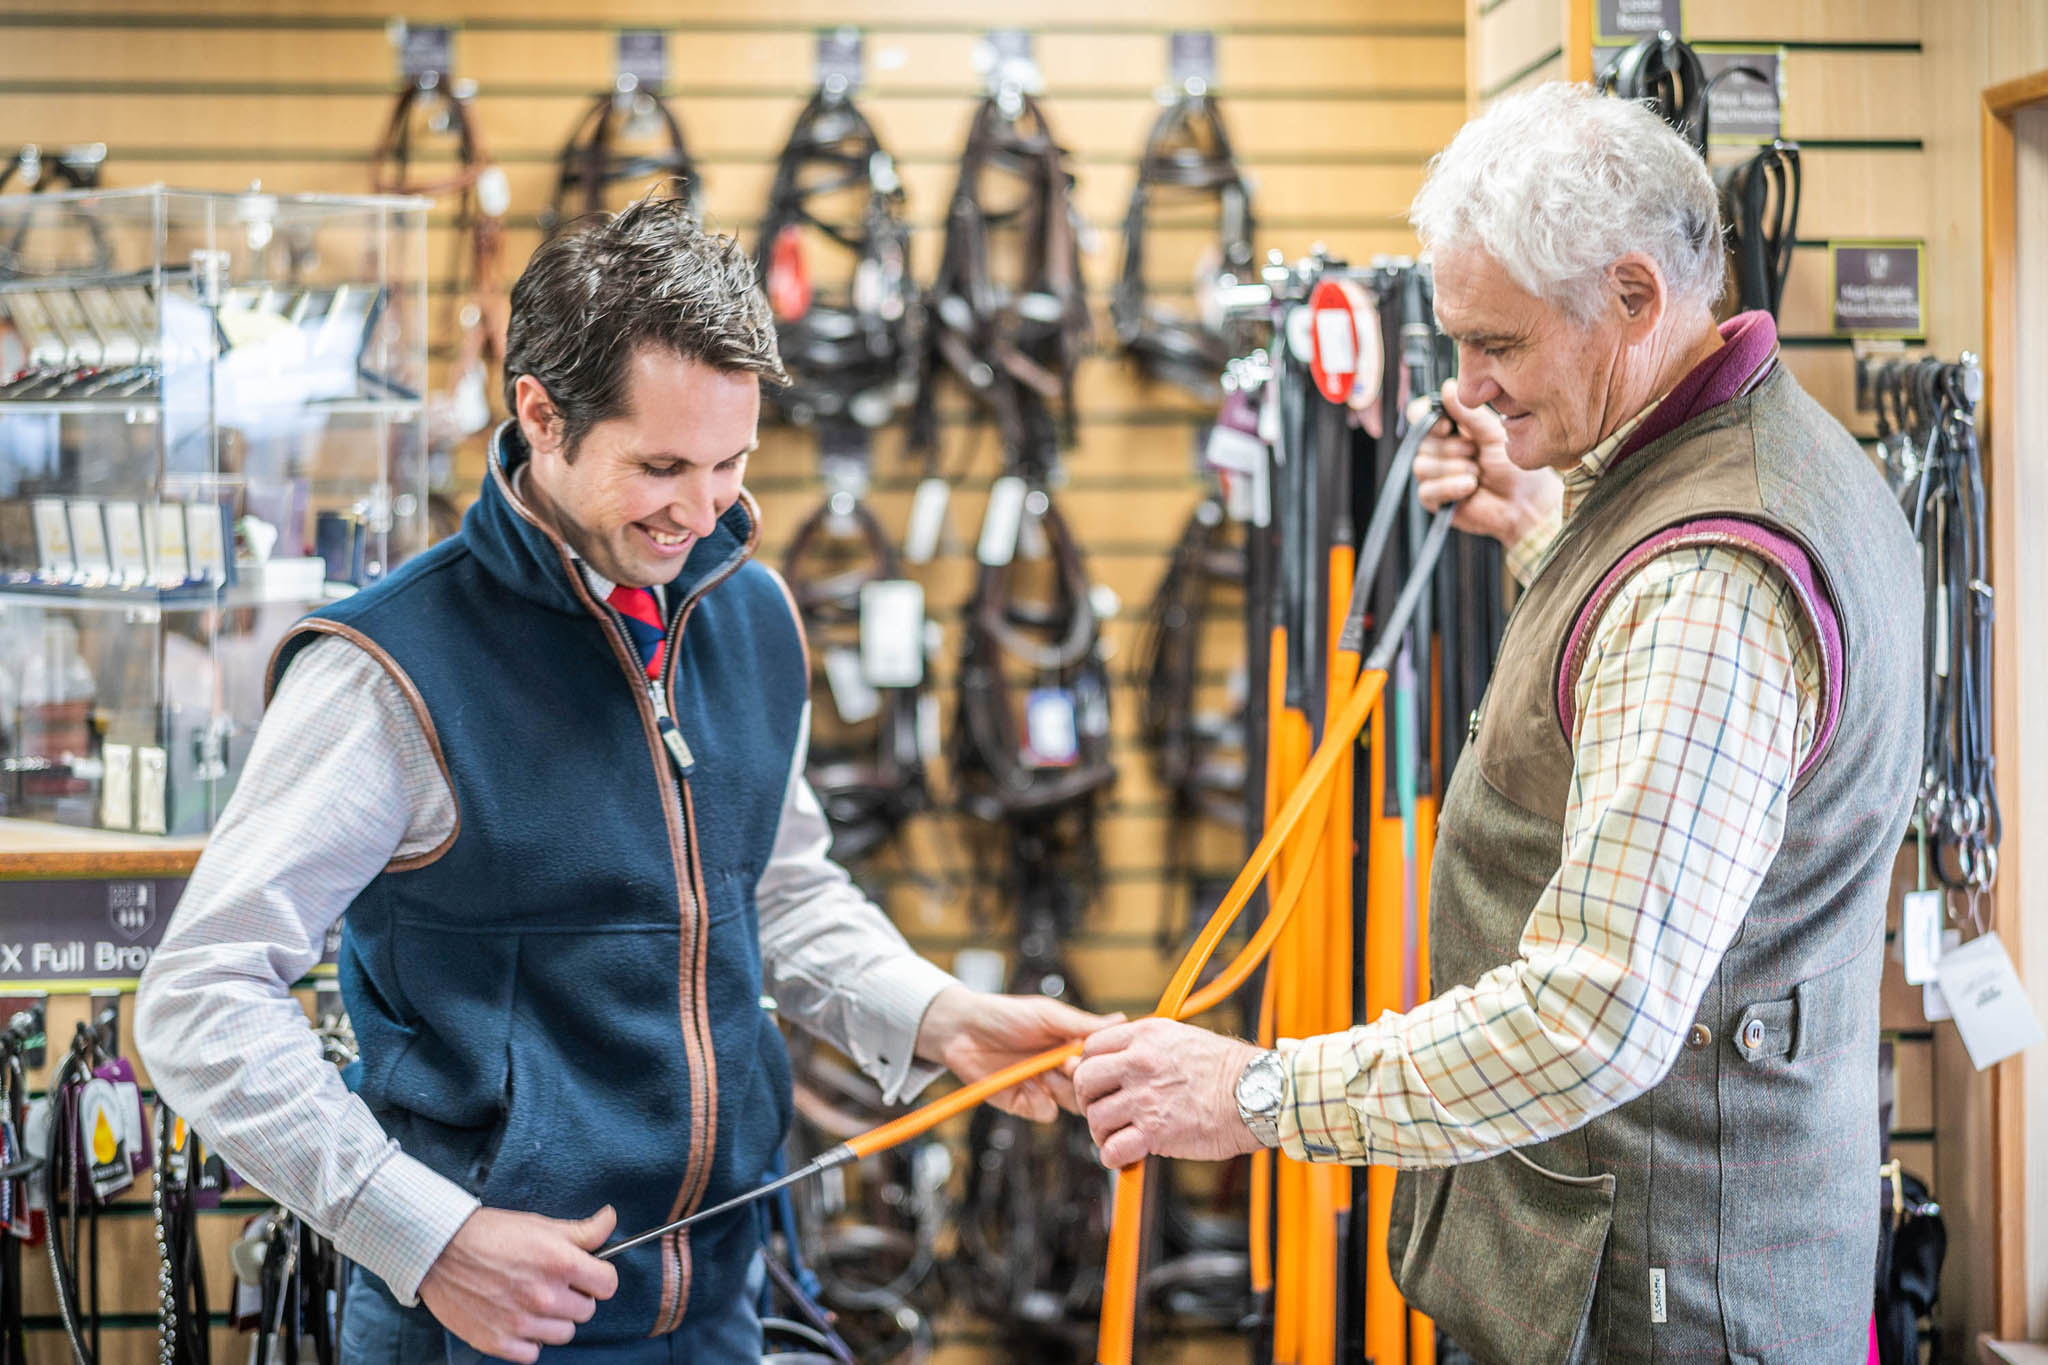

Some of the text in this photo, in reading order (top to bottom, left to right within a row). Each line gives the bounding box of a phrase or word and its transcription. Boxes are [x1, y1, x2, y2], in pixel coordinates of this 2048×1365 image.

[1, 941, 154, 973] X Full Bro
